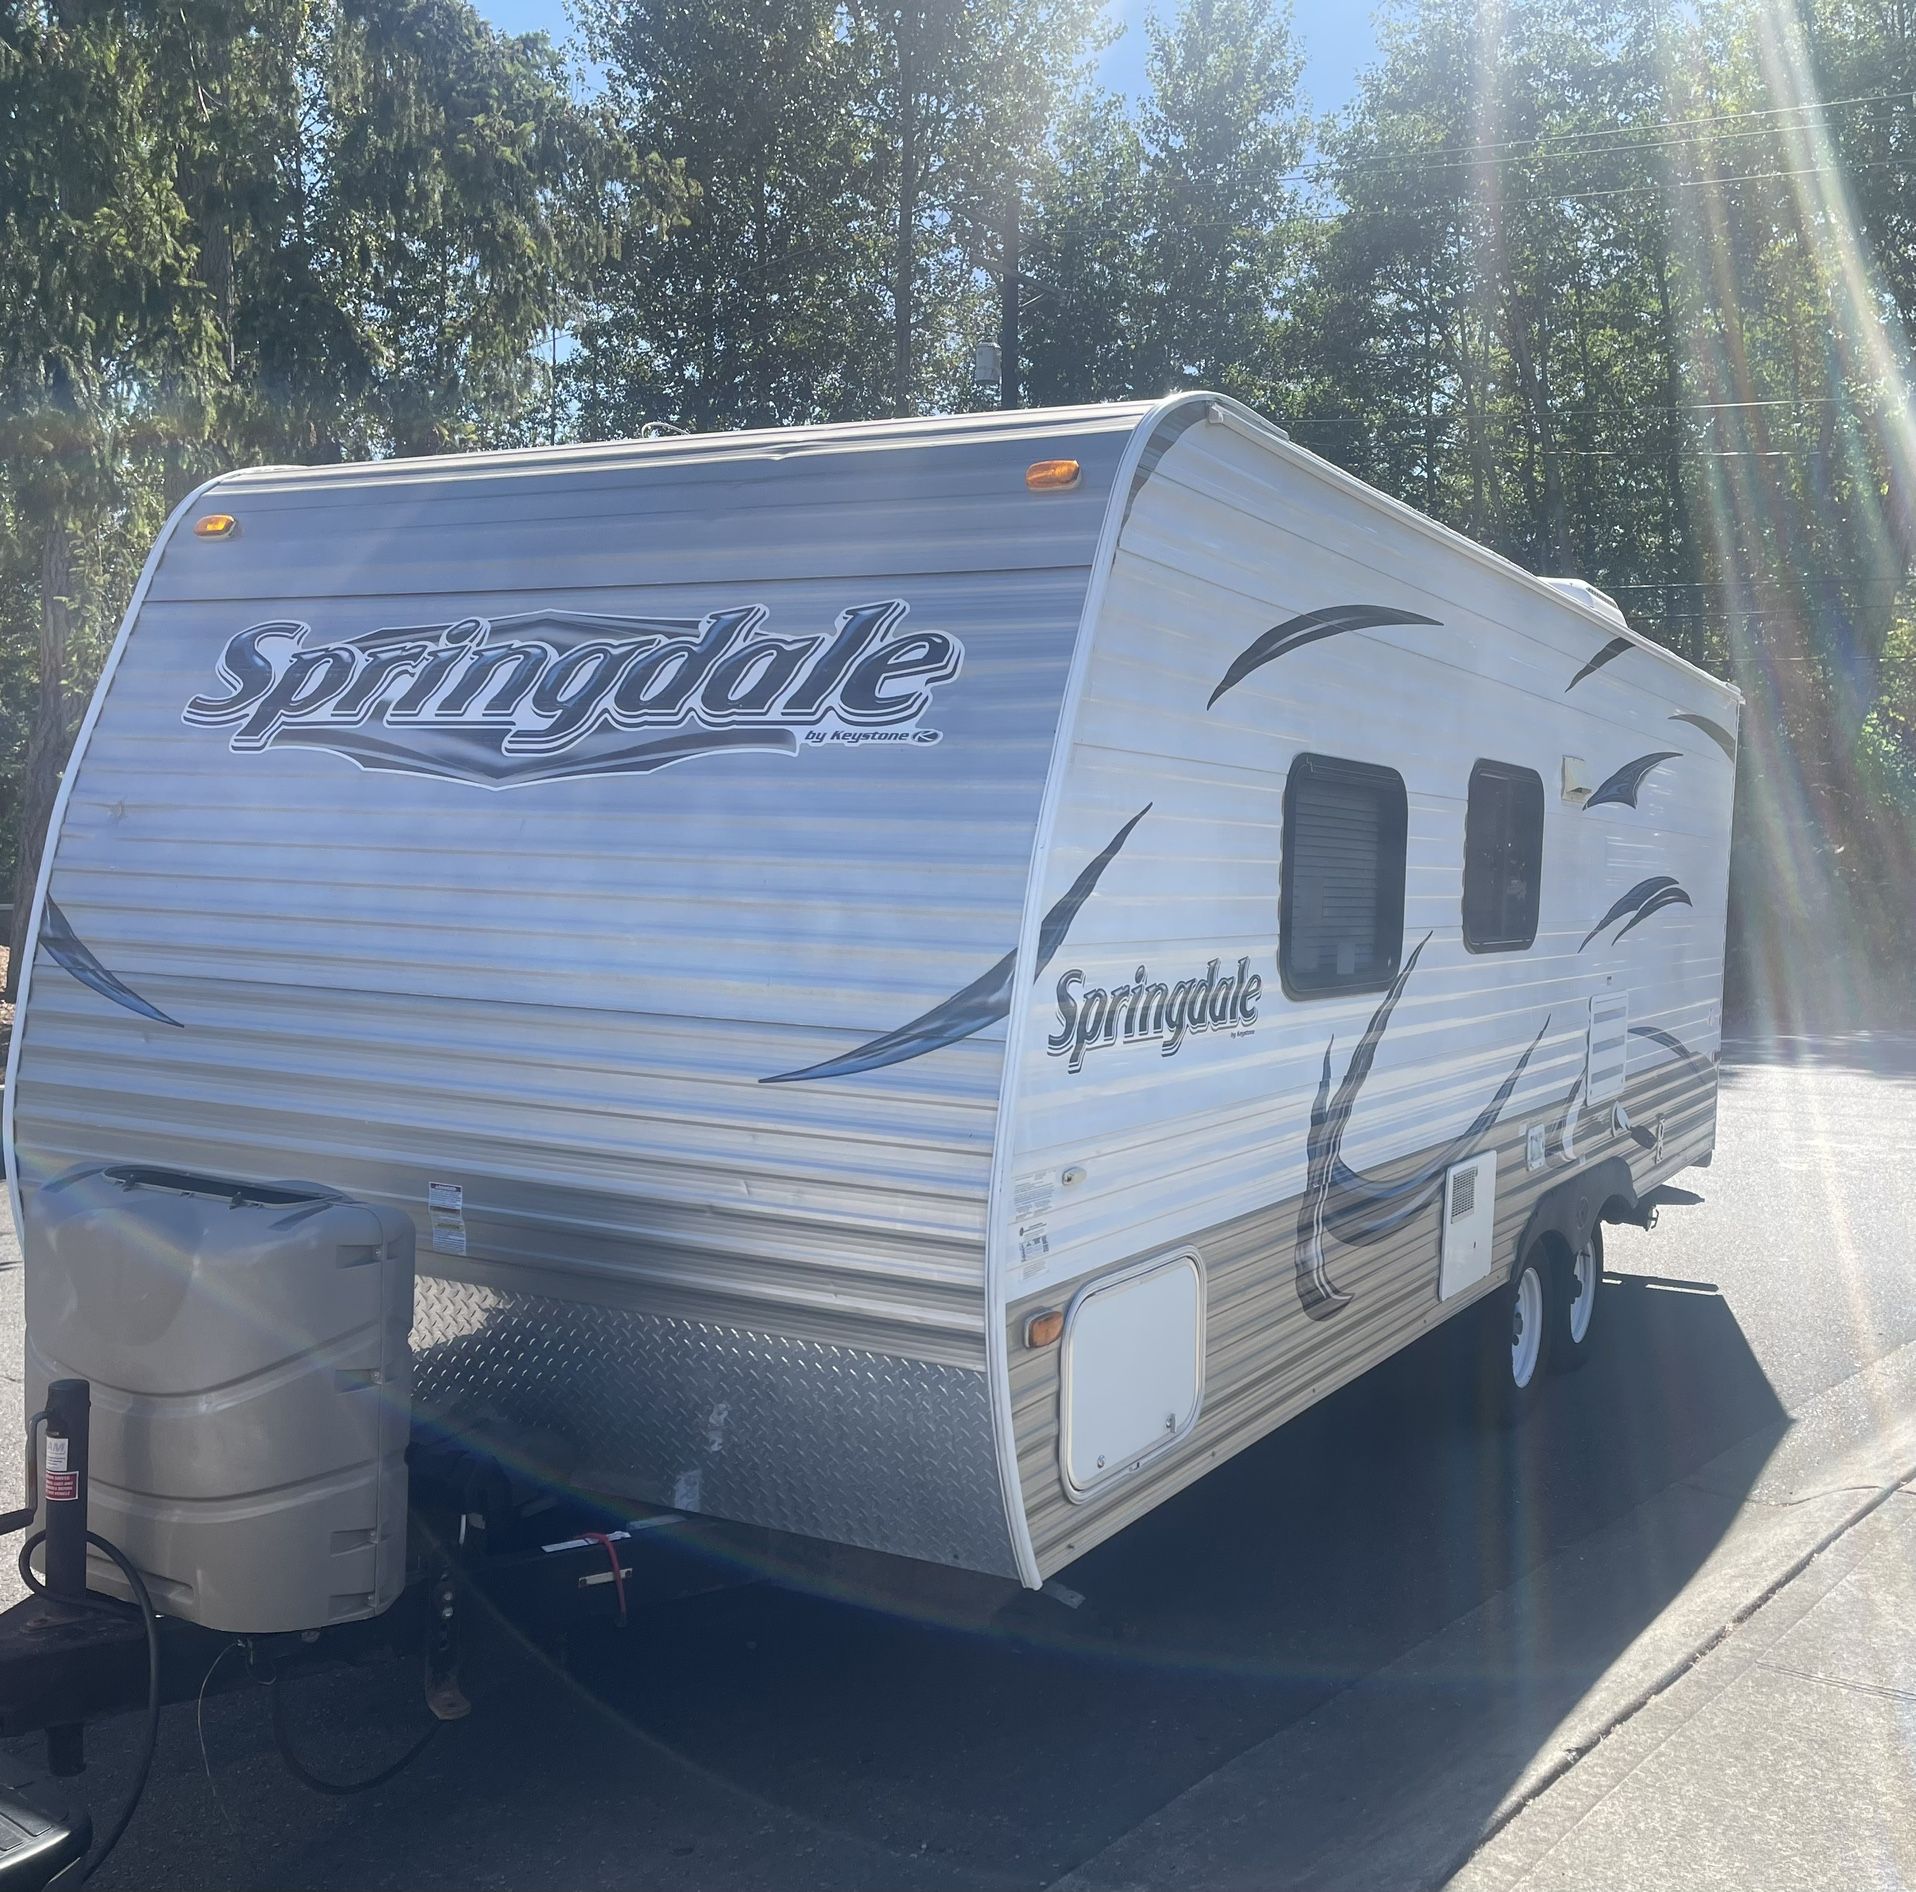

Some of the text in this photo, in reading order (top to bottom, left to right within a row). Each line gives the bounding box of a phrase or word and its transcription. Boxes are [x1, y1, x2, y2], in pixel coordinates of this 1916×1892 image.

[181, 600, 962, 754] Springdale
[805, 730, 909, 743] by Keystone
[1047, 956, 1262, 1074] Springdale
